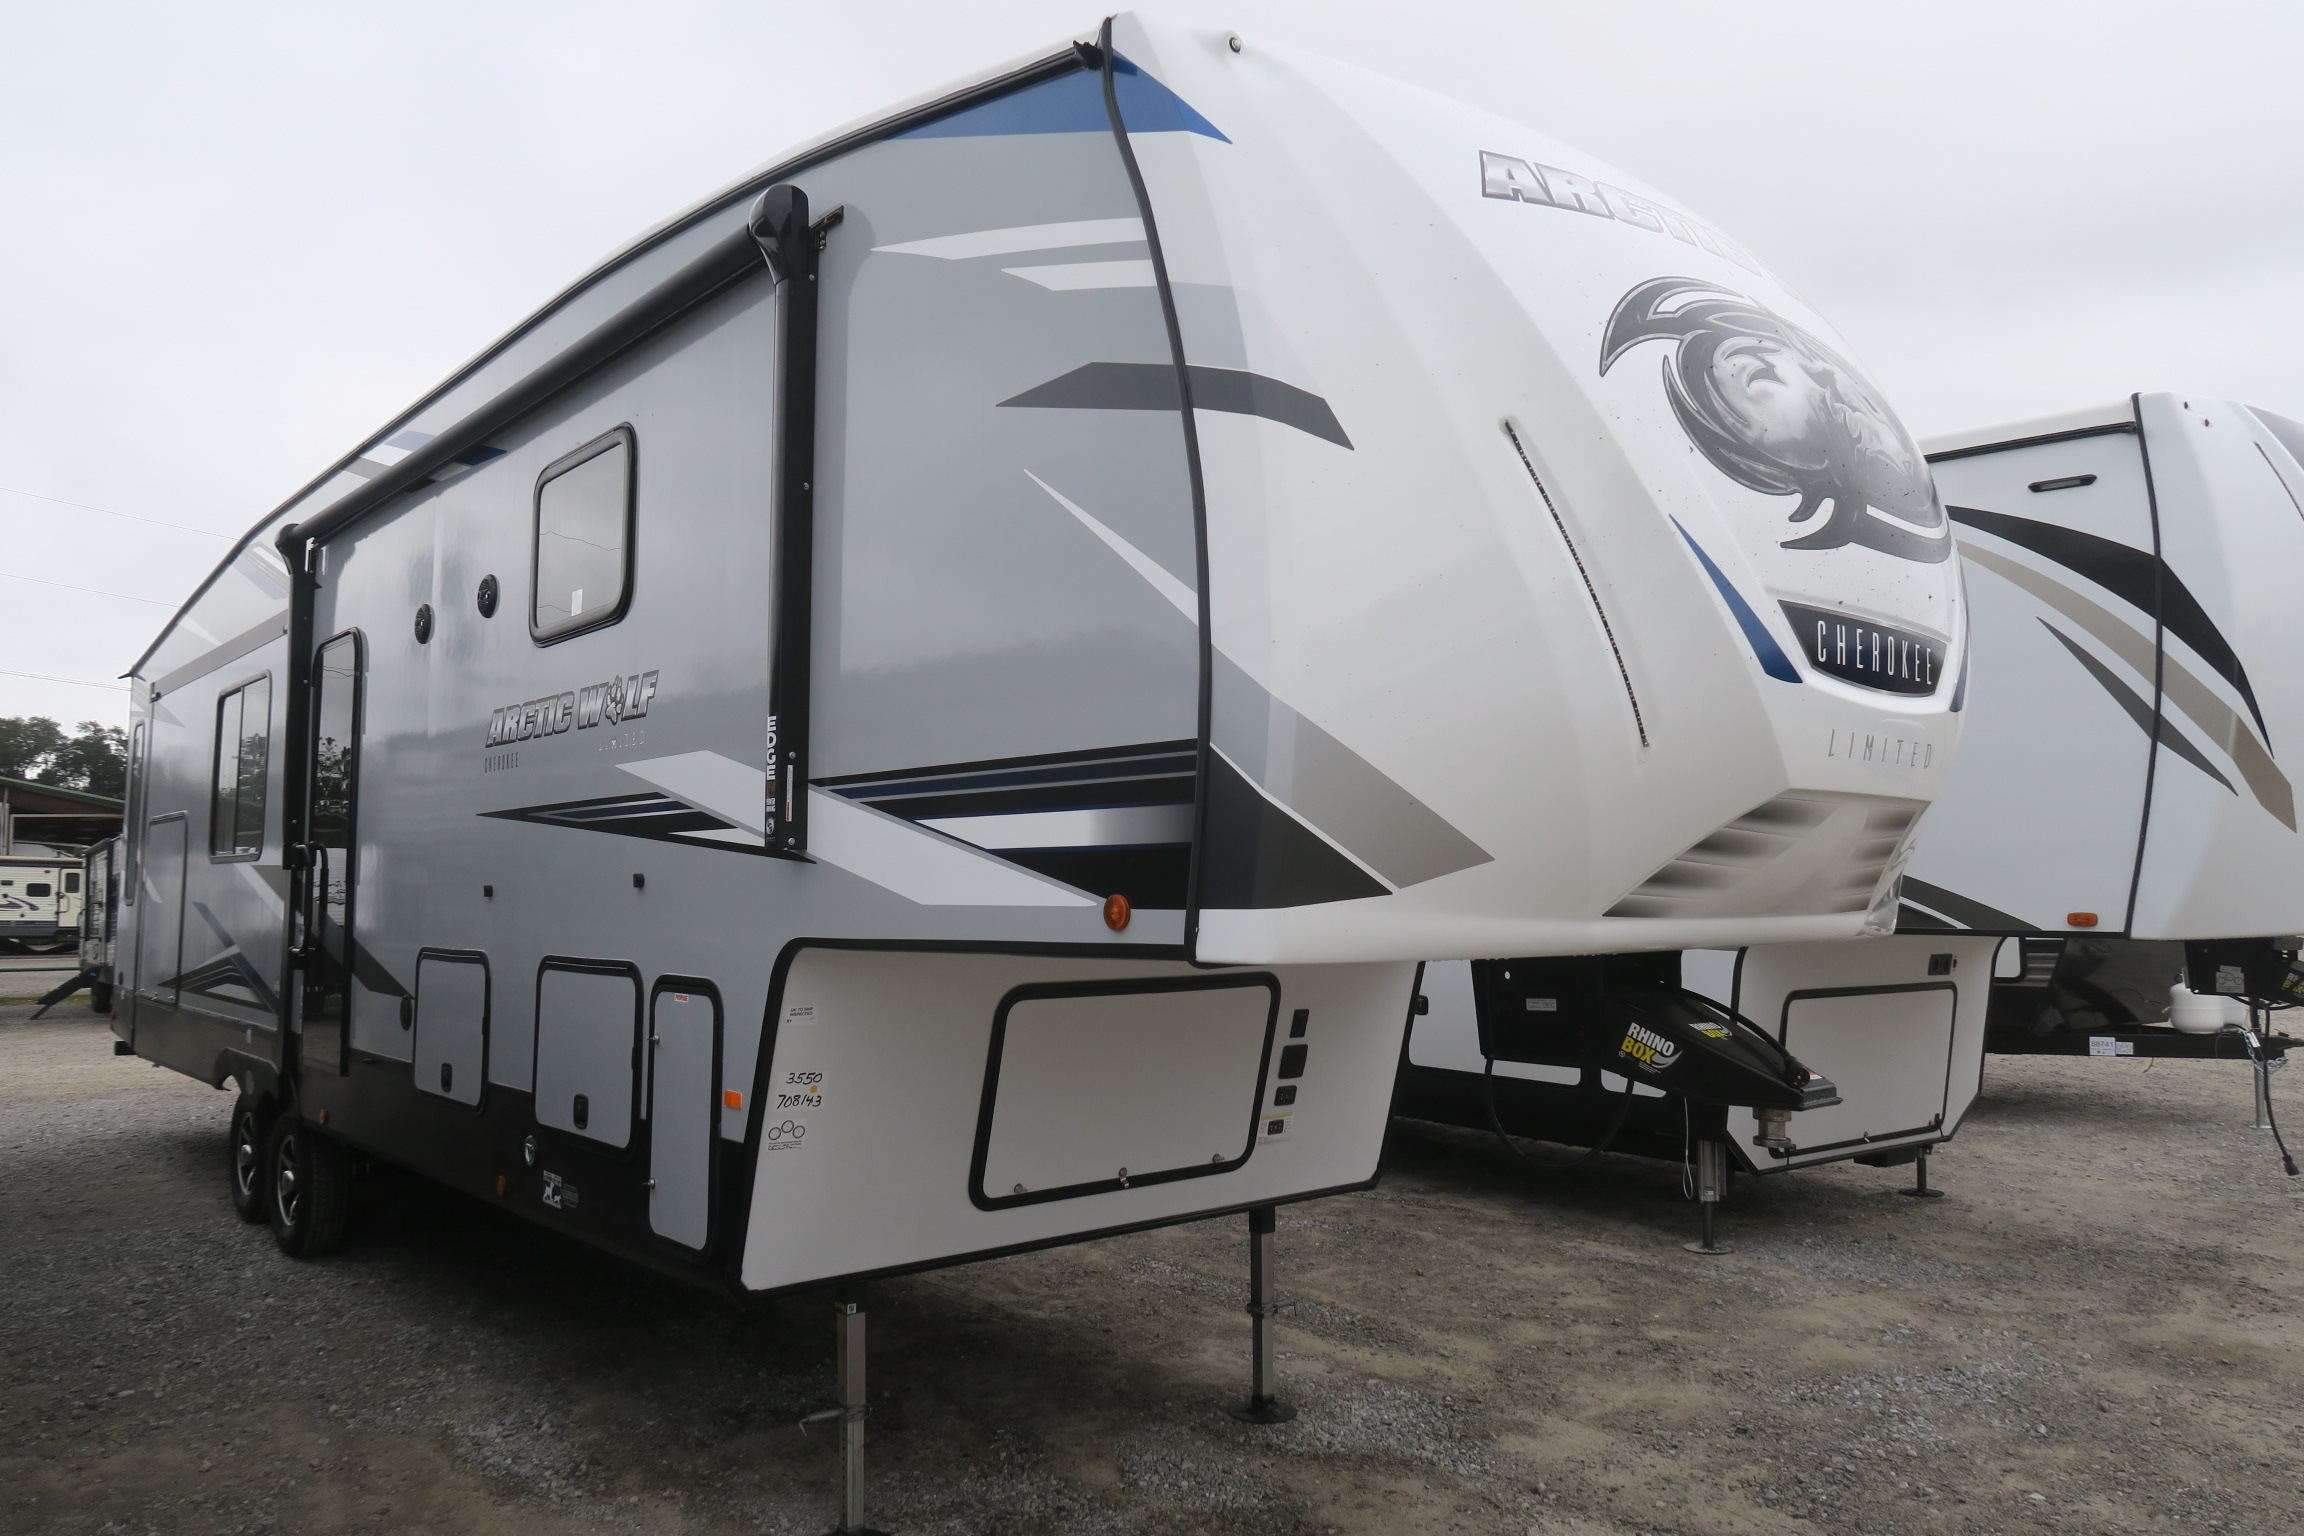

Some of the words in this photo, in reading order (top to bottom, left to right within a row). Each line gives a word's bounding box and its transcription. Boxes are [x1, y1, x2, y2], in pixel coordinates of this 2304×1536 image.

[1479, 149, 1763, 277] ARCTIC
[1817, 620, 1932, 685] CHEROKEE
[485, 691, 575, 748] ARCTIC
[484, 752, 519, 773] CHEROKEE
[766, 715, 777, 781] EDGE
[1828, 728, 1933, 770] LIMITED
[1621, 1035, 1657, 1065] BOX
[1627, 1022, 1675, 1057] RHINO
[785, 1072, 823, 1085] 3550
